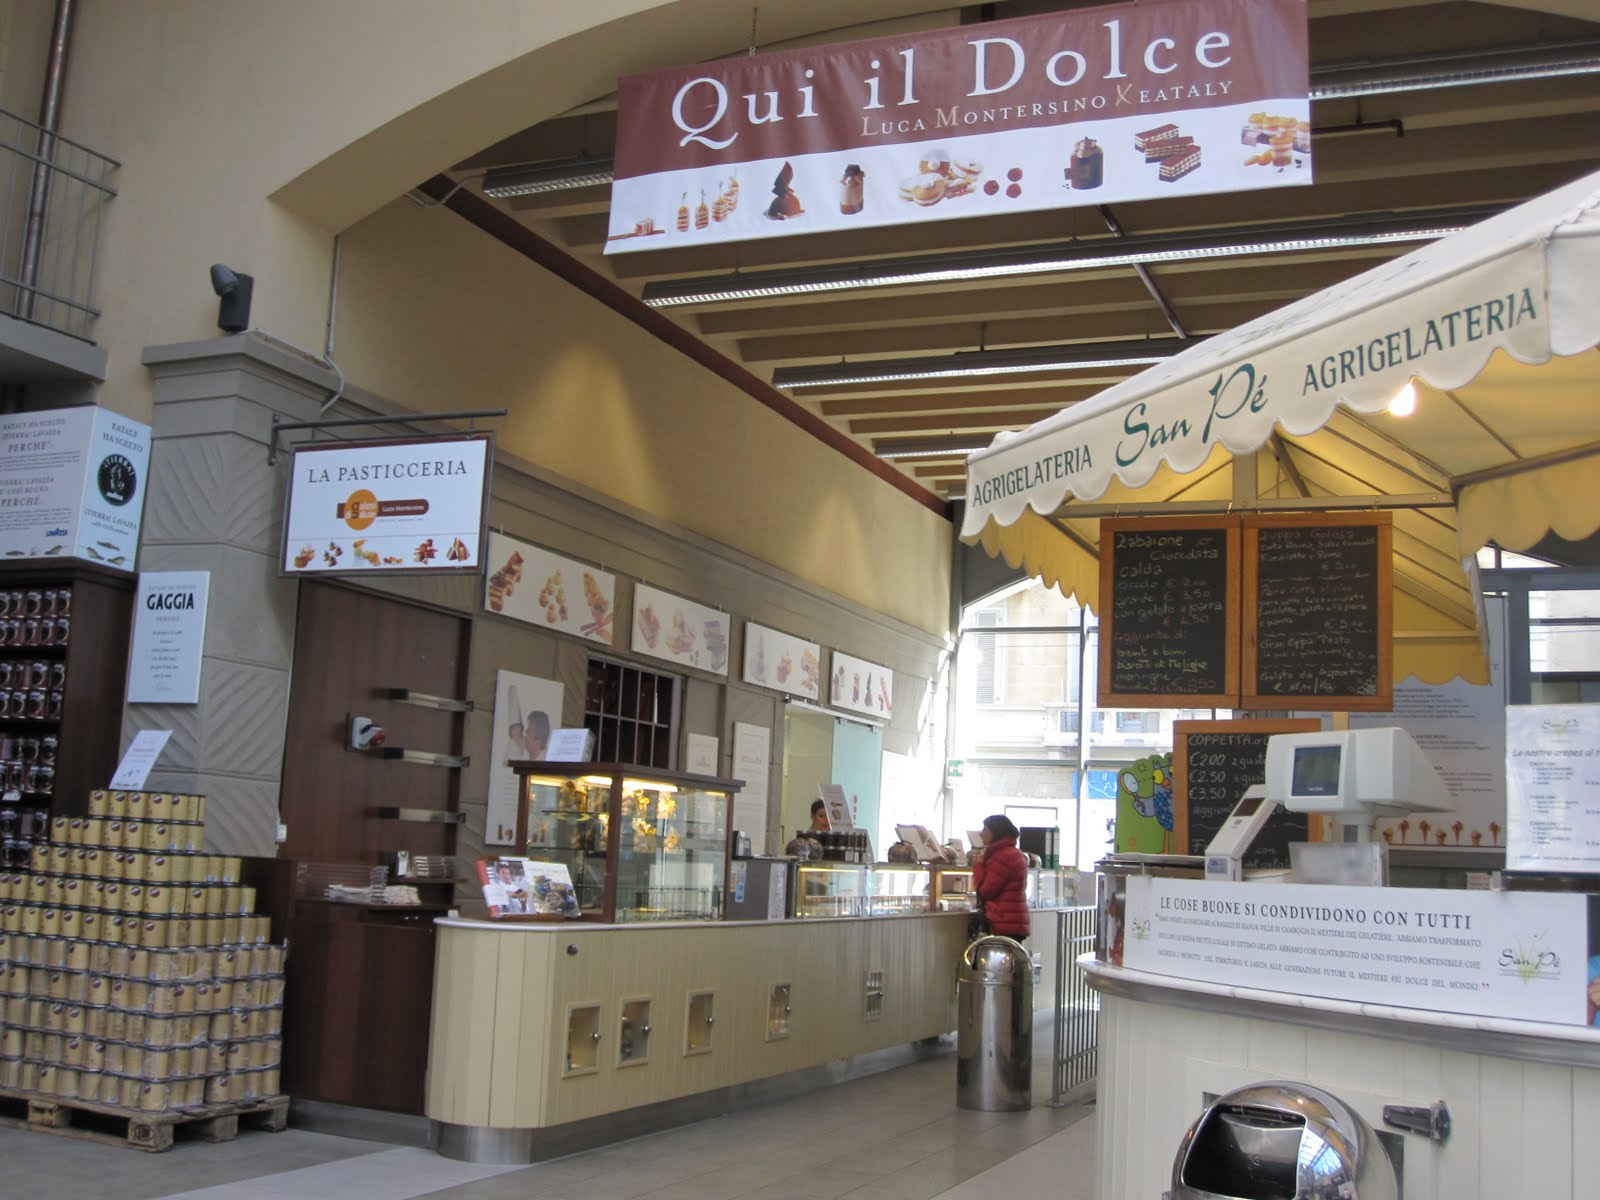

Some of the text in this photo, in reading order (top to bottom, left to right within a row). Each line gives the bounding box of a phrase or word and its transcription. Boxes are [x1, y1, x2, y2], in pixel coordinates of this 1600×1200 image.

[672, 20, 1233, 150] Qui il Dolce
[1140, 80, 1233, 104] EATALY
[1302, 287, 1538, 397] AGRIGELATERIA
[1116, 363, 1268, 468] San Pé
[309, 460, 468, 484] LA PASTICCERIA
[971, 444, 1092, 509] AGRIGELATERIA
[146, 592, 194, 610] GAGGIA
[1188, 734, 1251, 746] COPPETTA
[1160, 897, 1473, 930] LE COSE BUONE SI CONDIVIDONO CON TUTTI
[1346, 931, 1358, 939] DEL
[1396, 935, 1427, 944] ABBIAMO
[1428, 936, 1481, 948] TRASFORMATO
[1418, 956, 1463, 968] SOSTENIBILE
[1464, 960, 1481, 969] CHE
[1323, 969, 1346, 978] FUTURE
[1358, 973, 1388, 982] MESTIERE
[1405, 976, 1428, 986] DOLCE
[1432, 979, 1446, 988] DEL
